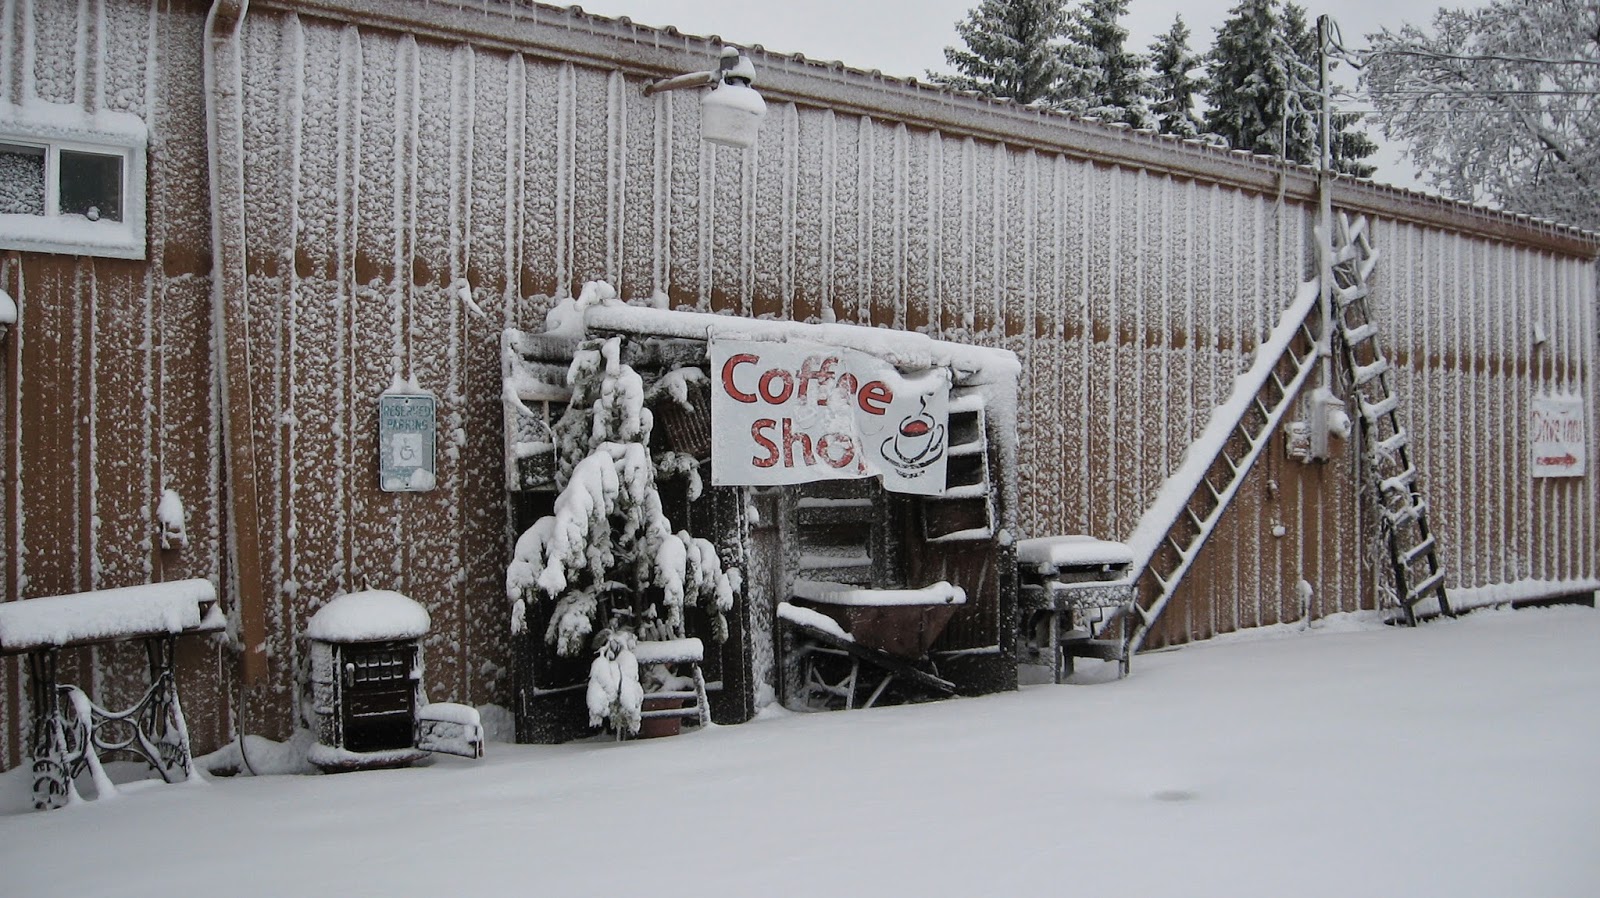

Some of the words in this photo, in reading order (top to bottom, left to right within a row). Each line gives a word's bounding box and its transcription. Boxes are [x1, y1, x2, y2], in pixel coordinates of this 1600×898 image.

[384, 405, 431, 417] RESERVED
[387, 419, 428, 430] PARKING
[751, 417, 868, 476] Sho
